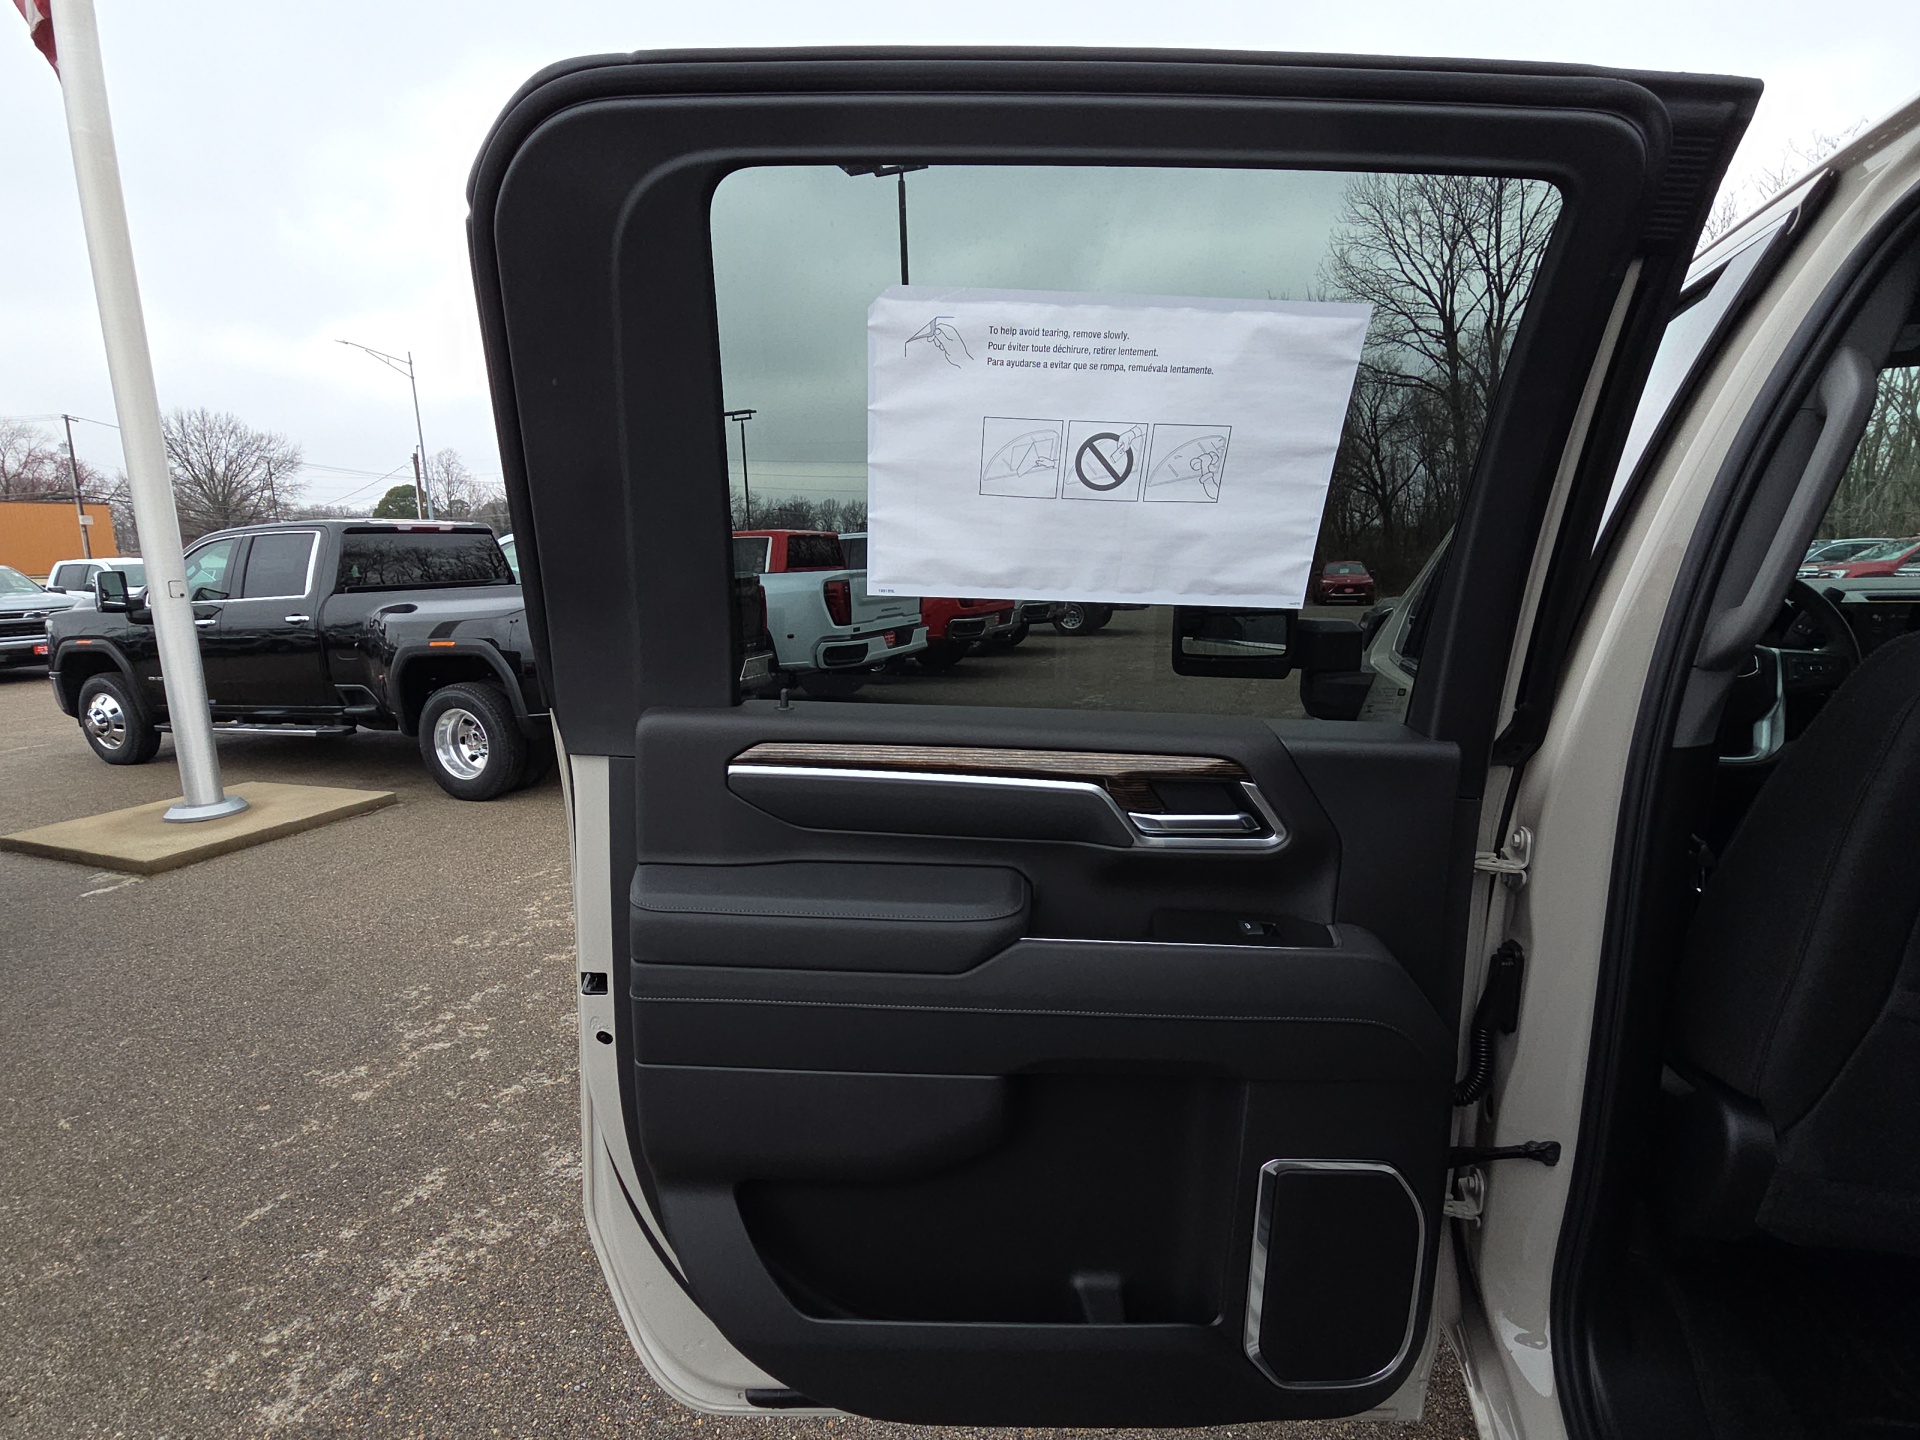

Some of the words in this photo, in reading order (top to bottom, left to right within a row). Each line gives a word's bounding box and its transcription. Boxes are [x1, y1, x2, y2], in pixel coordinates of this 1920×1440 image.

[988, 326, 998, 335] To
[1000, 327, 1017, 337] help
[1019, 328, 1040, 337] avoid
[1042, 328, 1071, 339] tearing,
[1073, 330, 1102, 338] remove
[1103, 330, 1130, 342] slowly.
[988, 342, 1006, 351] Pour
[1008, 342, 1029, 352] éviter
[1031, 344, 1050, 353] toute
[1052, 344, 1091, 355] déchirure,
[1093, 346, 1116, 356] retirer
[1118, 346, 1158, 357] lentement.
[987, 357, 1004, 366] Para
[1006, 358, 1041, 368] ayudarse
[1050, 360, 1071, 370] evitar
[1073, 362, 1088, 372] que
[1100, 364, 1126, 372] rompa,
[1128, 362, 1168, 374] remuévala
[1170, 365, 1214, 375] lentamente.
